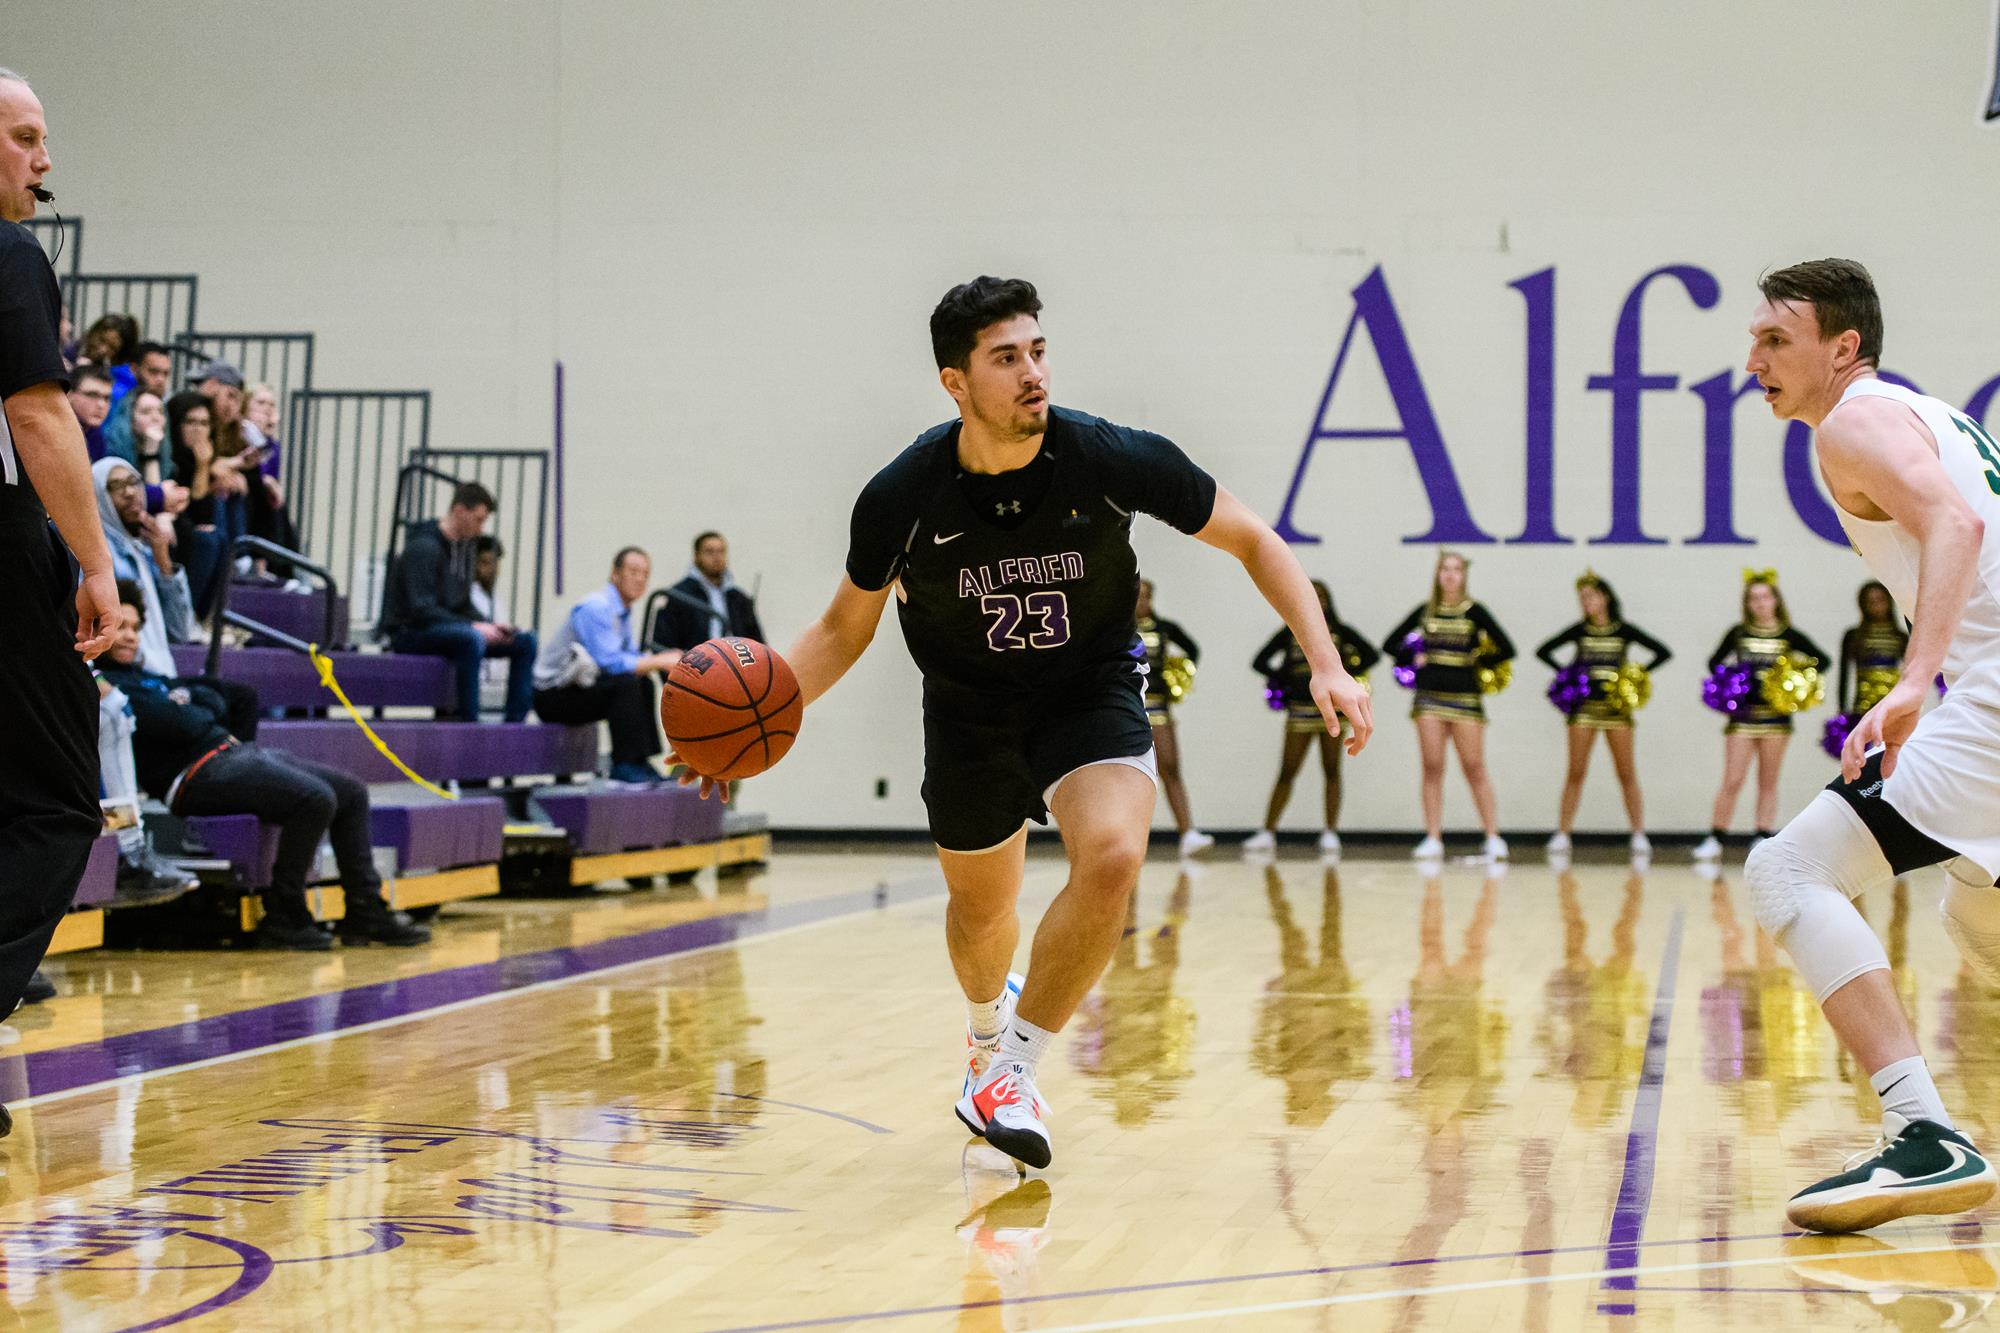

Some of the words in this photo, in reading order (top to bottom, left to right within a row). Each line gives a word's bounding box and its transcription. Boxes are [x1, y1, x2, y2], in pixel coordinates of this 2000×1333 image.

[1275, 262, 2000, 549] Alfr
[1947, 411, 2000, 496] 3
[958, 551, 1085, 598] ALFRED
[981, 590, 1071, 652] 23
[1857, 780, 1884, 799] Reeb
